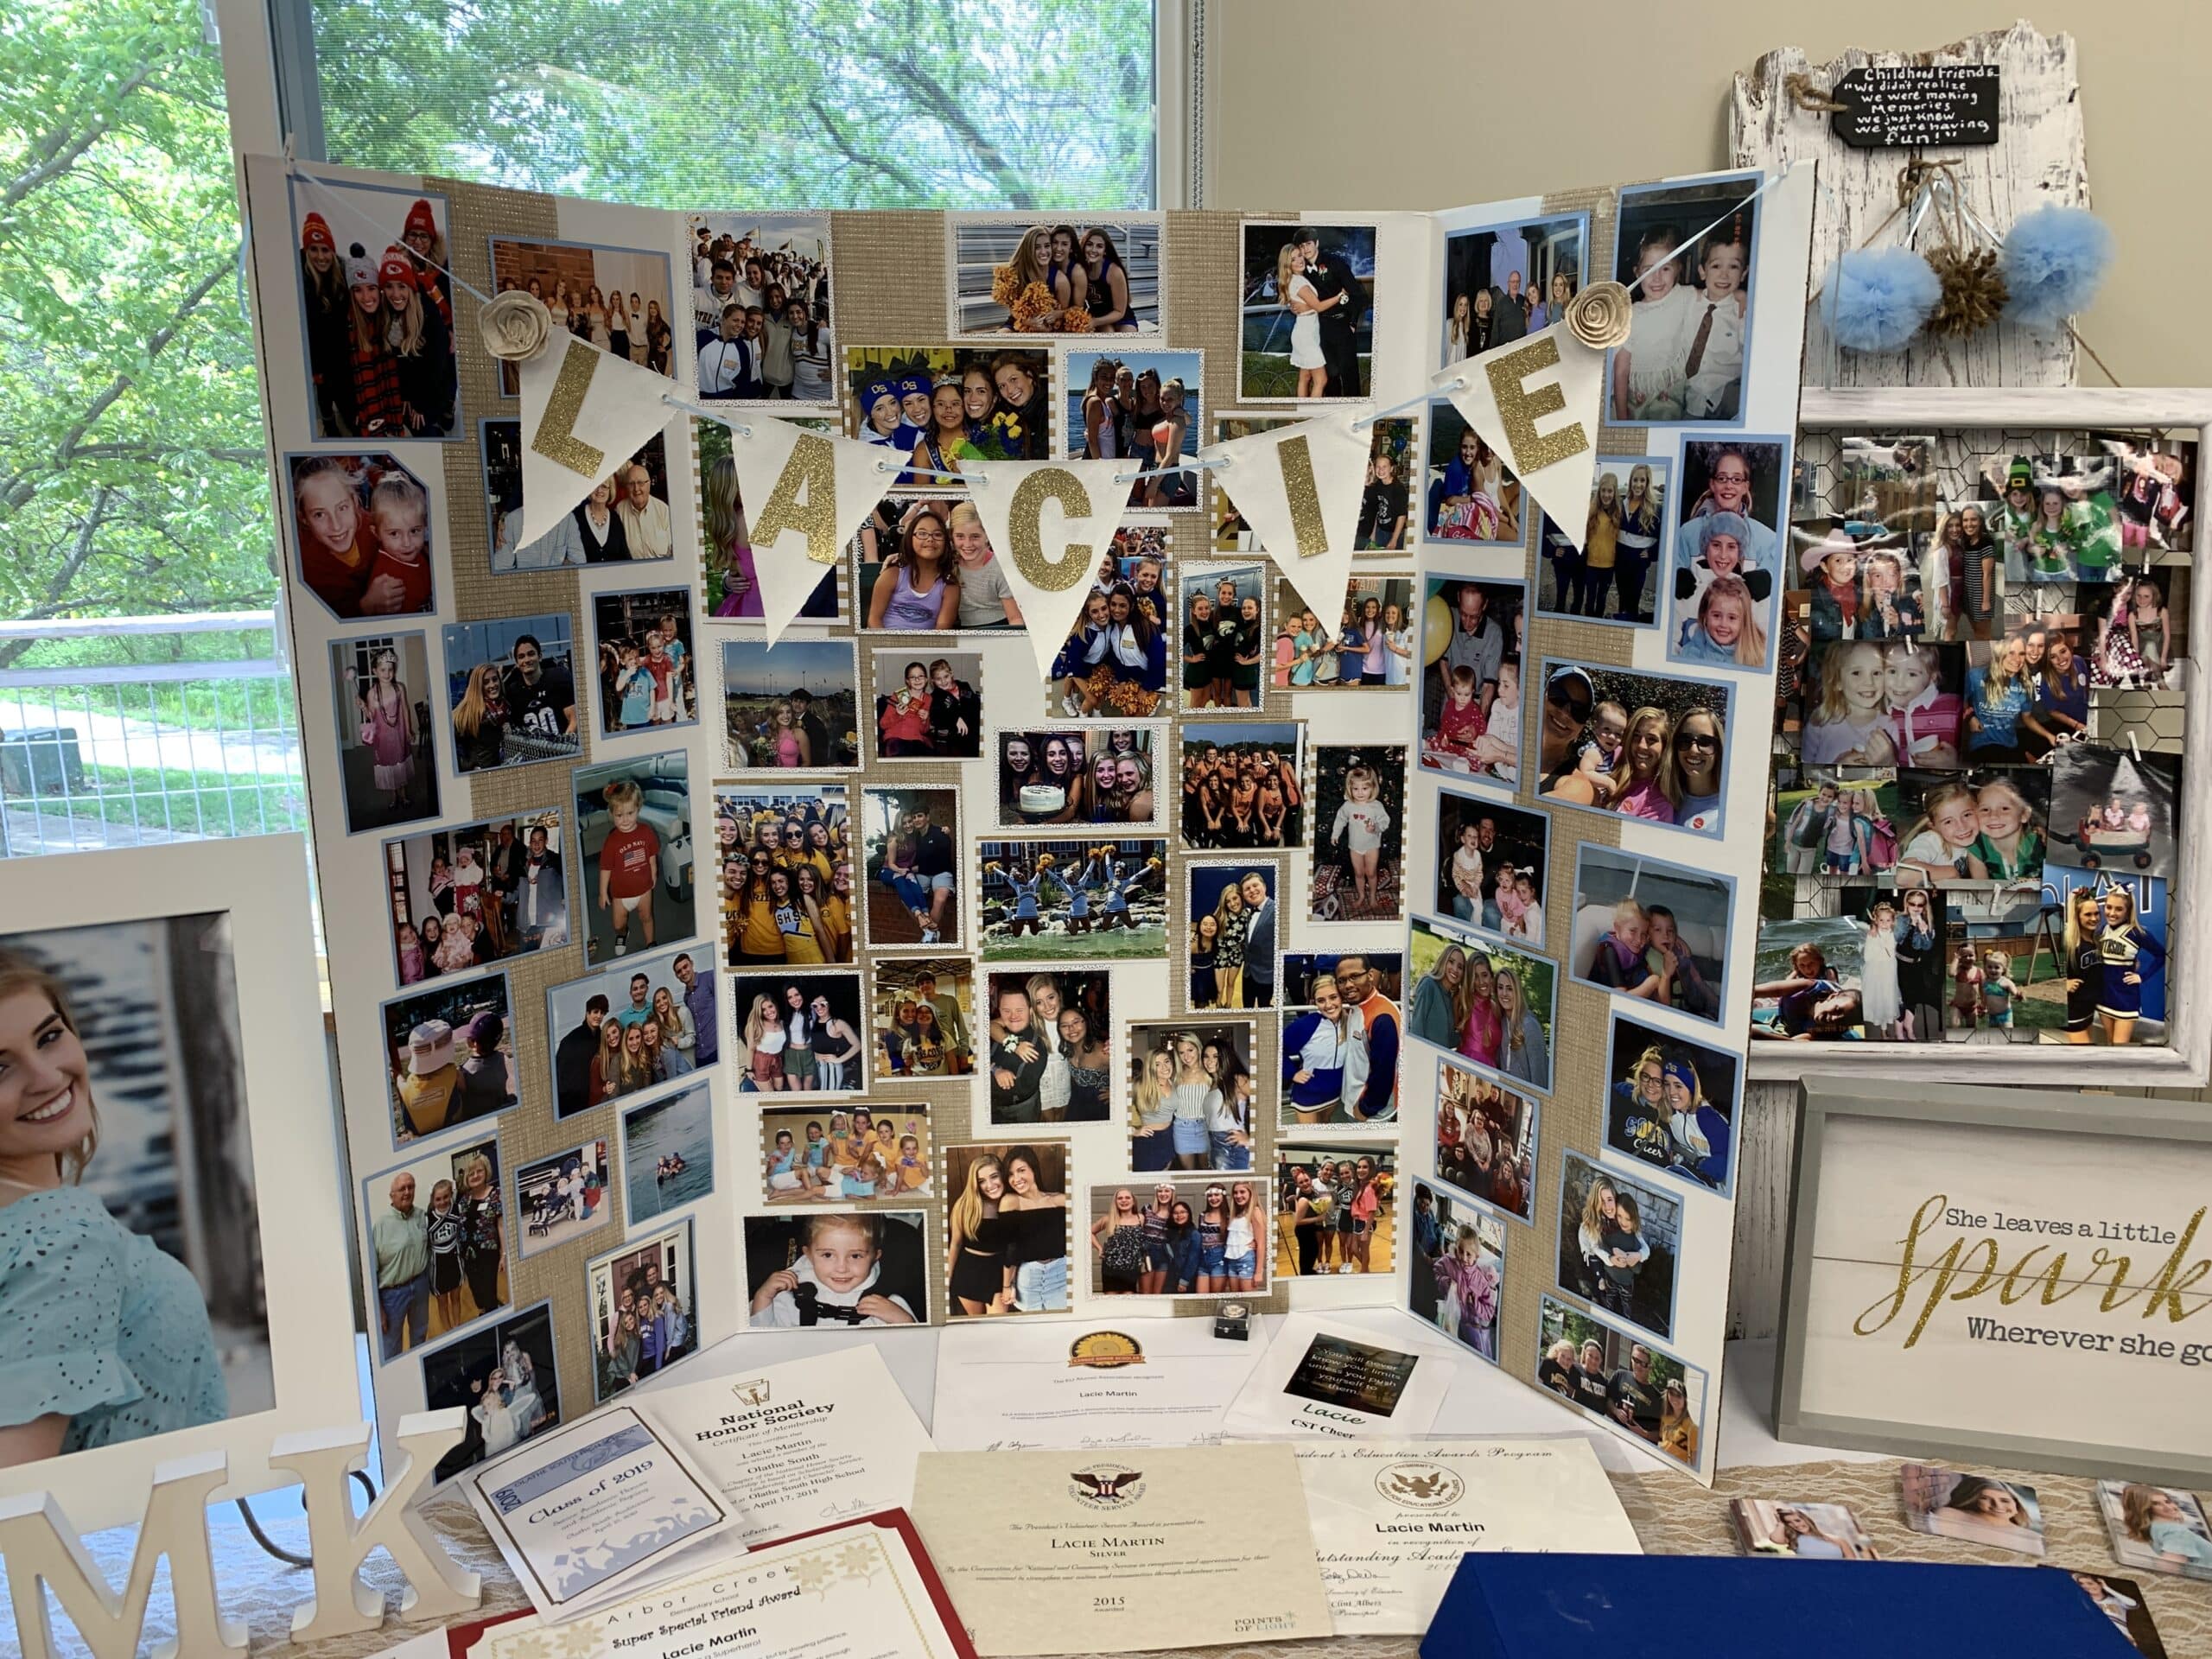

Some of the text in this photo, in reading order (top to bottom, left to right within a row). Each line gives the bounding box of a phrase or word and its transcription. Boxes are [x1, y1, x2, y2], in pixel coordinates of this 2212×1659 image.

[1865, 68, 1934, 81] Childhood
[1880, 80, 1910, 91] didn't
[1917, 80, 1966, 90] realize
[1888, 92, 1921, 100] were
[1885, 113, 1910, 124] just
[1888, 122, 1925, 131] were
[1930, 120, 1989, 132] having
[1633, 1138, 1664, 1159] Ceer
[1945, 1209, 2176, 1244] She leaves a little
[1967, 1317, 2113, 1351] Wherever
[2120, 1332, 2175, 1358] she
[1312, 1354, 1401, 1380] know your limits
[1324, 1349, 1397, 1370] You will never
[1308, 1363, 1342, 1374] unless
[1369, 1377, 1396, 1387] push
[1319, 1374, 1363, 1388] yourself
[695, 1422, 758, 1441] Honor
[764, 1403, 835, 1425] Society
[720, 1400, 805, 1425] National
[1303, 1403, 1367, 1424] Lacie
[713, 1432, 760, 1447] Certificate
[774, 1417, 828, 1433] Membership
[1291, 1419, 1356, 1439] CST Cheer
[741, 1448, 772, 1459] Lacie
[775, 1439, 812, 1452] Martin
[1353, 1449, 1419, 1459] Education
[1424, 1448, 1479, 1459] Awards
[1487, 1448, 1552, 1459] Program
[747, 1461, 785, 1474] Olathe
[787, 1453, 820, 1465] South
[514, 1468, 547, 1488] OLATHE
[749, 1489, 779, 1499] Olathe
[781, 1482, 808, 1491] South
[810, 1477, 833, 1485] High
[835, 1467, 865, 1478] School
[529, 1497, 582, 1523] Class
[588, 1479, 607, 1496] of
[613, 1460, 653, 1484] 2019
[753, 1498, 777, 1509] April
[796, 1488, 818, 1497] 2018
[1376, 1522, 1485, 1533] Lacie Martin
[1052, 1536, 1165, 1548] LACIE MARTIN
[1403, 1539, 1465, 1548] recognition
[1315, 1548, 1463, 1566] utstanding Acade
[607, 1565, 794, 1624] Arbor Creek
[1093, 1597, 1125, 1606] 2015
[612, 1586, 802, 1649] Super Special Friend Award
[1235, 1617, 1282, 1625] POINTS
[663, 1627, 757, 1659] Lacie Martin
